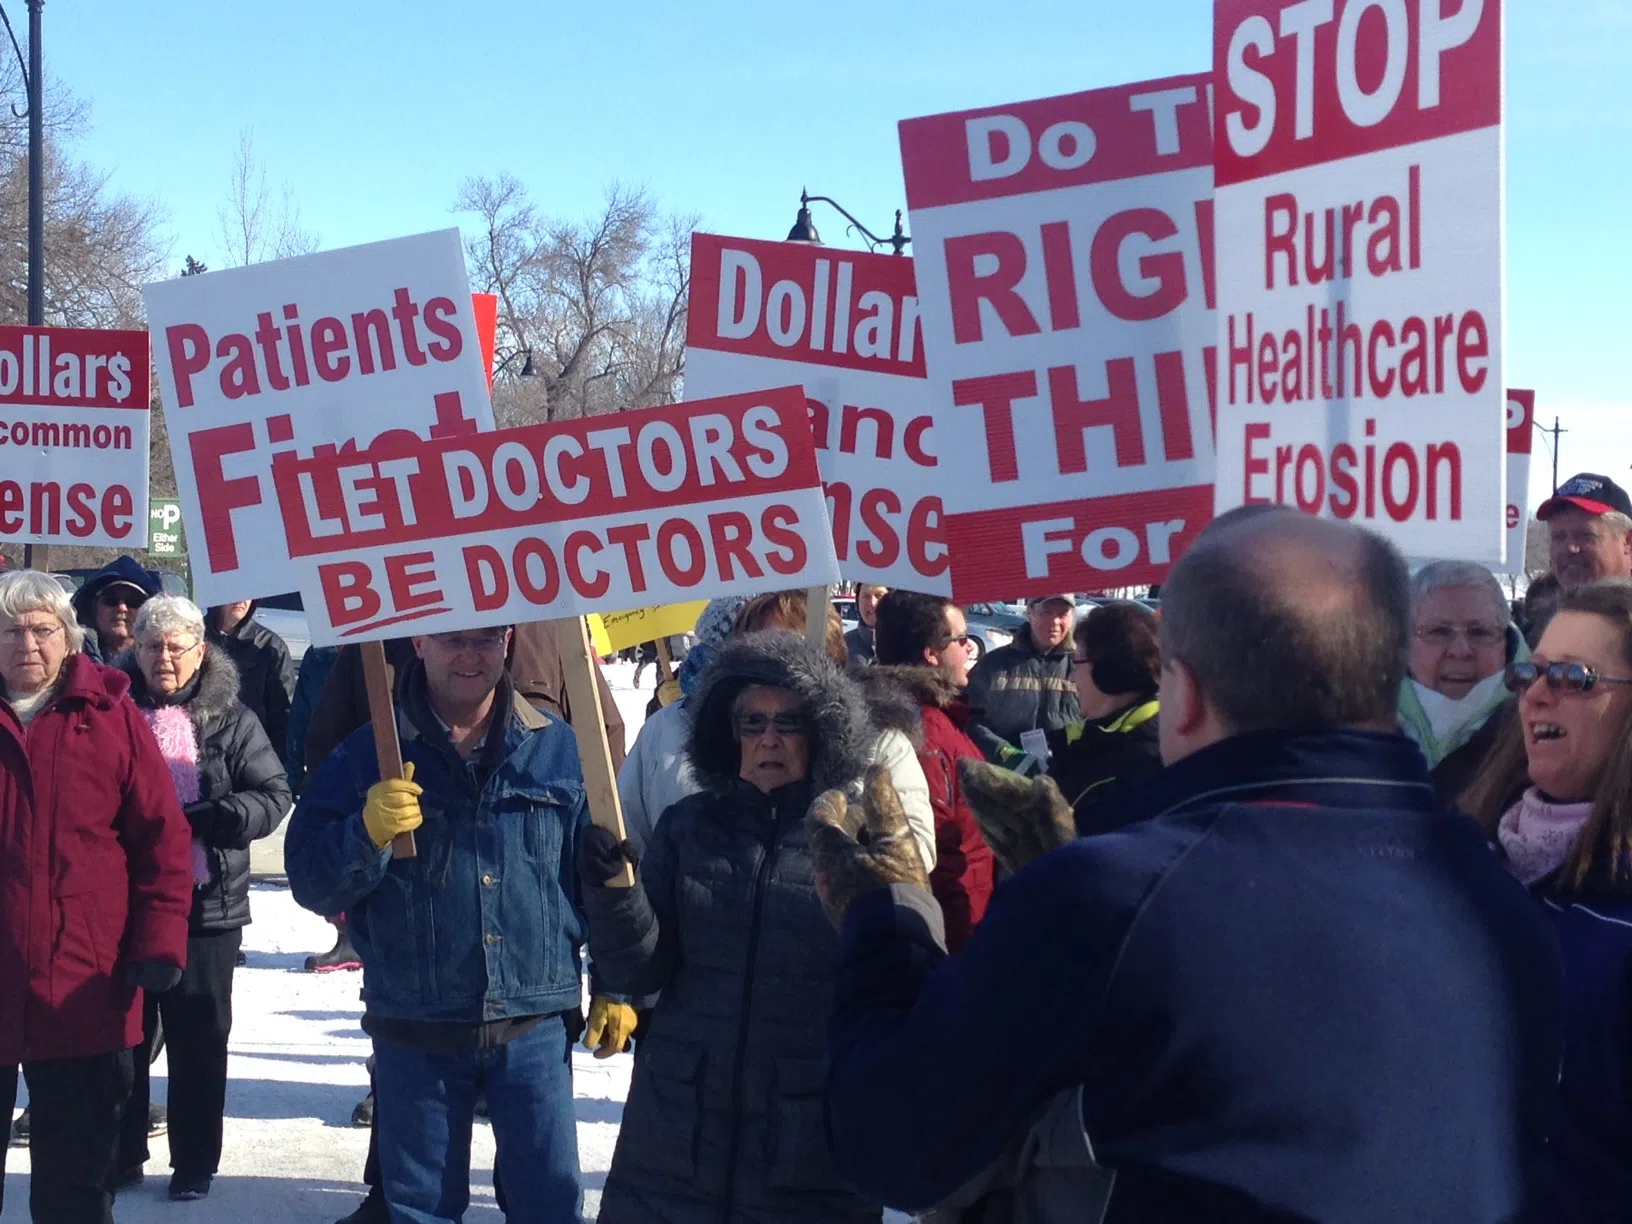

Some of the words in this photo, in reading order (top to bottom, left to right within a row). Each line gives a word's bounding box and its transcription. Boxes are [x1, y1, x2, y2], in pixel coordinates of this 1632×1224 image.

[1226, 0, 1484, 157] STOP
[965, 114, 1097, 182] Do
[943, 198, 1215, 344] RIG
[1265, 164, 1420, 289] Rural
[166, 287, 463, 408] Patients
[1228, 301, 1489, 405] Healthcare
[952, 345, 1216, 483] THI
[0, 479, 133, 539] ense
[151, 508, 164, 519] NO
[163, 504, 181, 530] P
[297, 456, 420, 539] LET
[441, 405, 790, 520] DOCTORS
[1244, 418, 1462, 522] Erosion
[153, 532, 178, 543] Either
[154, 542, 175, 553] Side
[318, 551, 445, 628] BE
[462, 504, 807, 612] DOCTORS
[1021, 516, 1186, 579] For
[603, 608, 645, 629] Emergency
